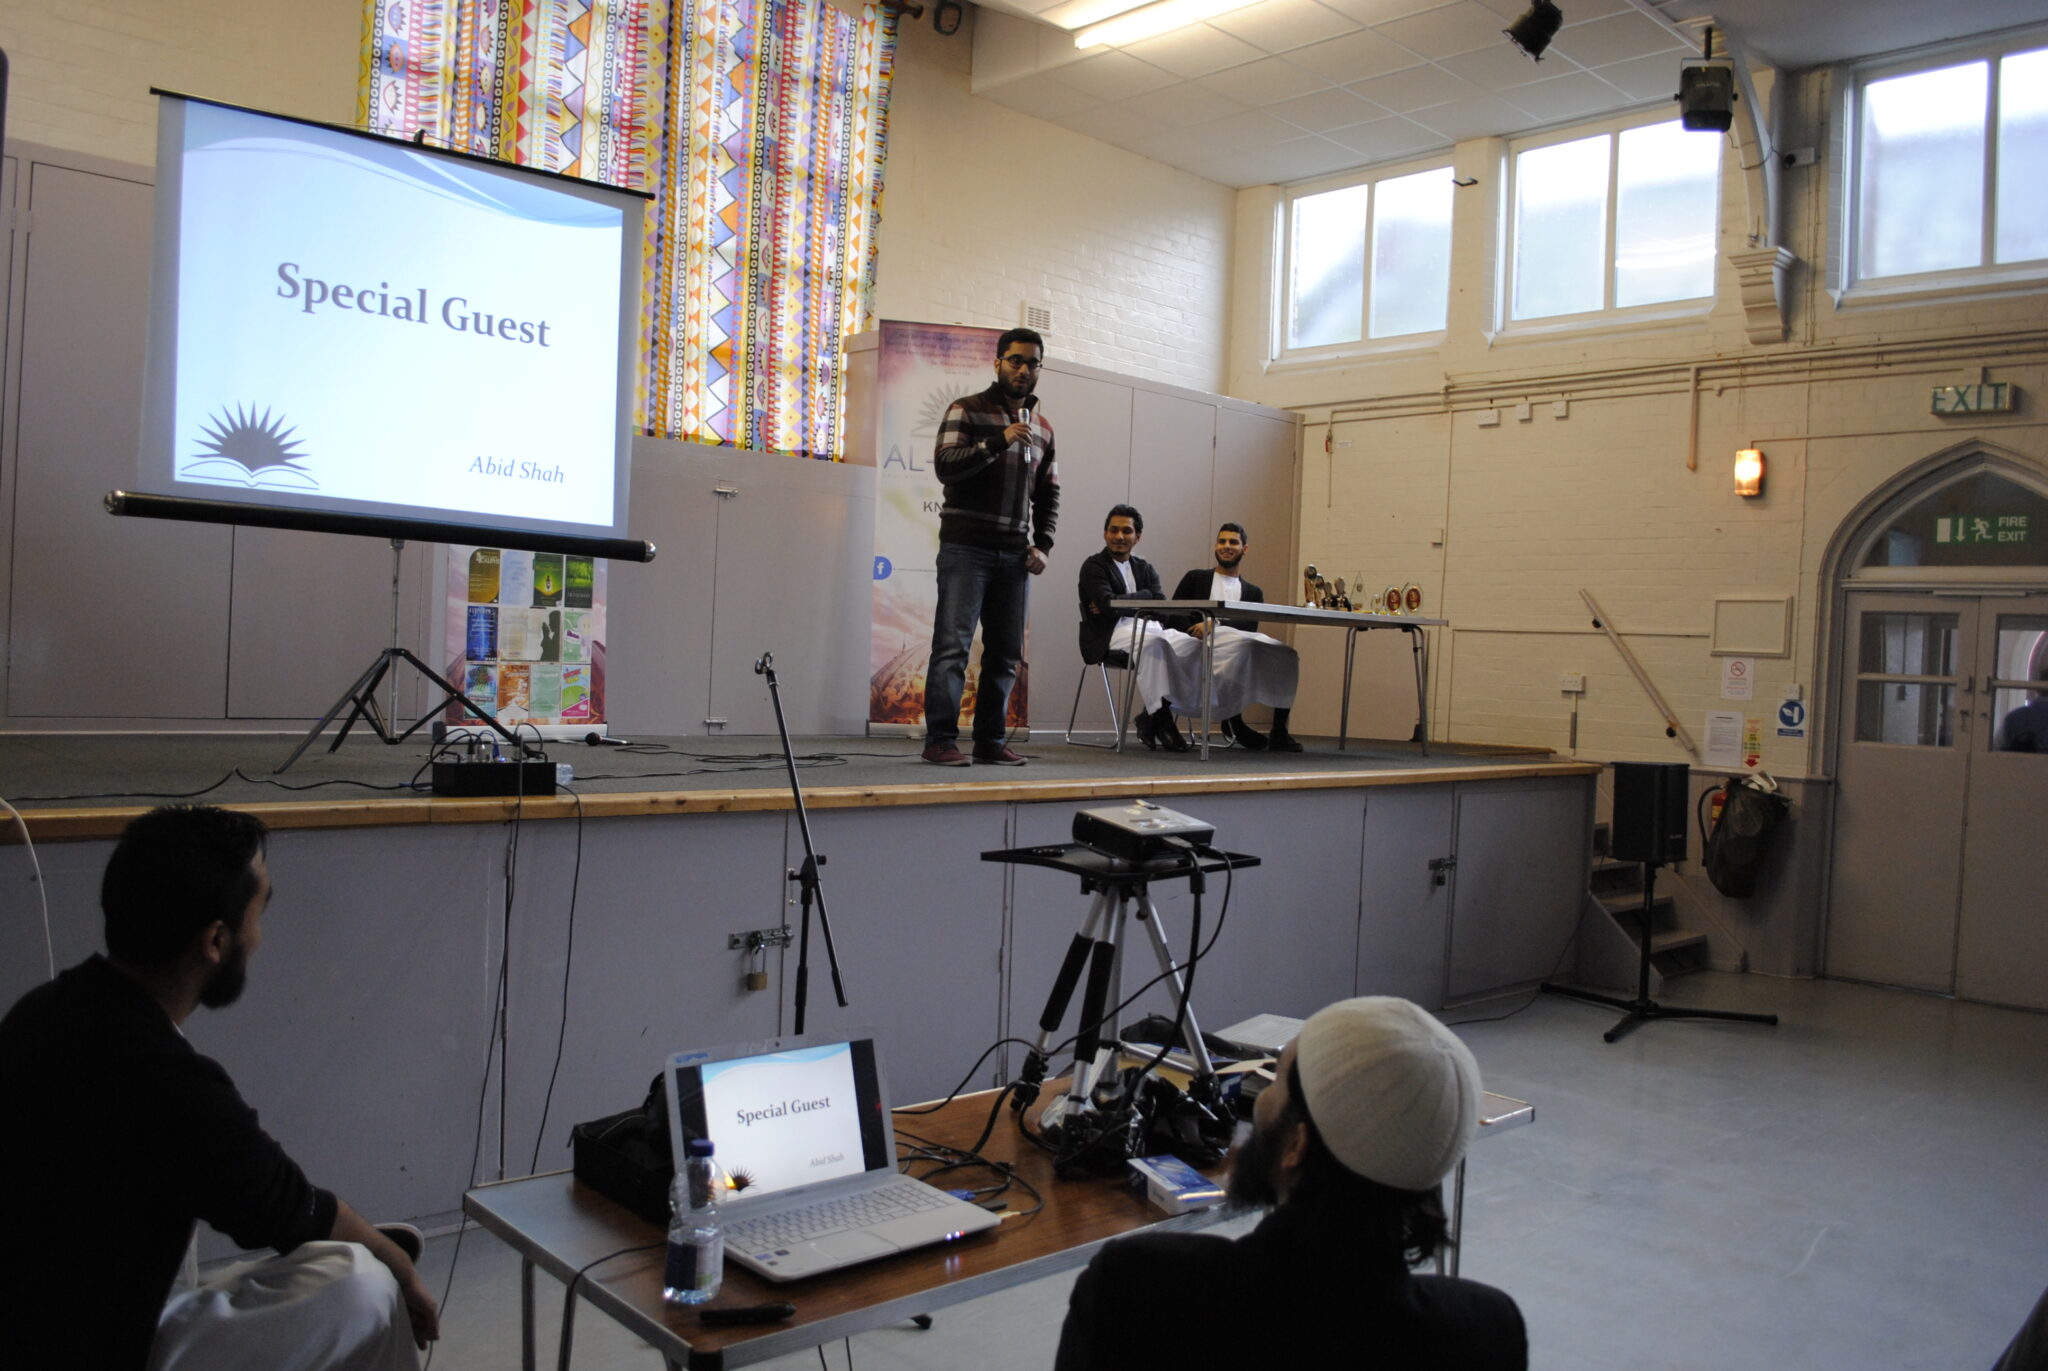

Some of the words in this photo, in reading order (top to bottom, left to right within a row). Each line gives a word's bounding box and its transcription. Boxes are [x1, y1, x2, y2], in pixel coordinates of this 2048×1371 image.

[276, 261, 429, 325] Special
[441, 296, 551, 348] Guest
[1931, 382, 2007, 412] EXIT
[467, 455, 516, 478] Abid
[518, 460, 565, 484] Shah
[1997, 531, 2027, 542] EXIT
[1998, 516, 2028, 528] FIRE
[736, 1101, 788, 1126] Special
[791, 1096, 832, 1114] Guest
